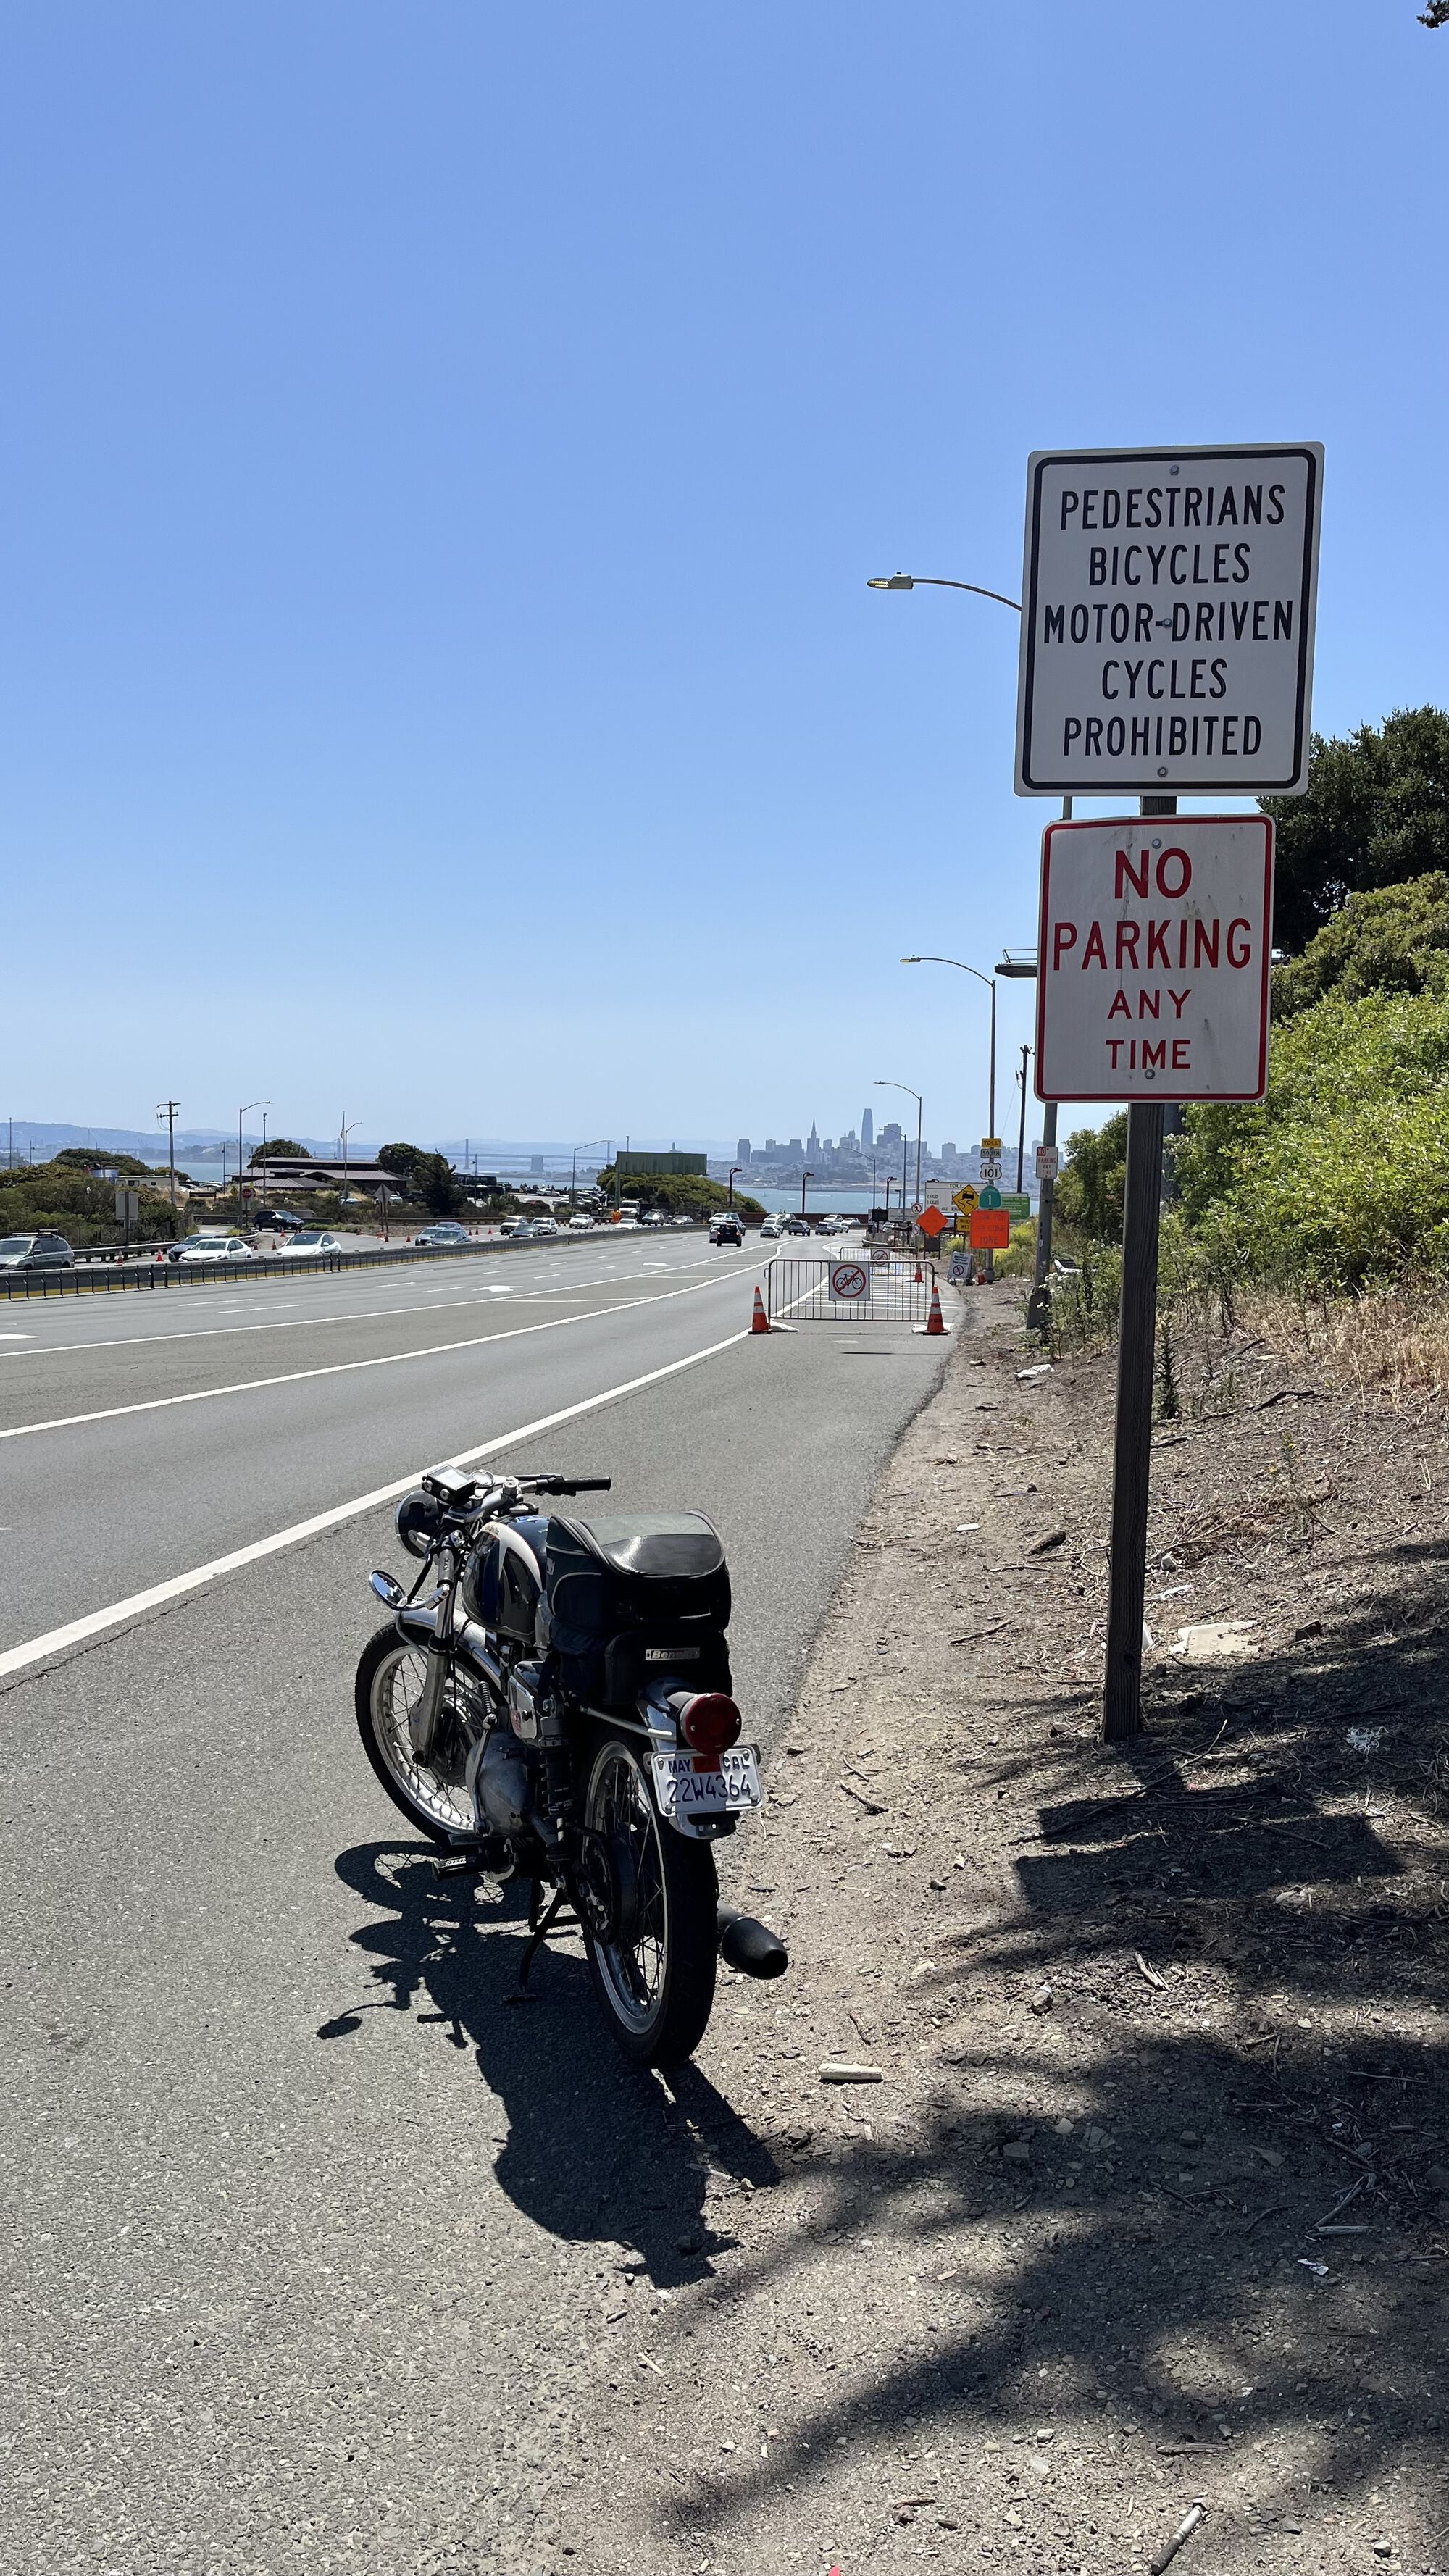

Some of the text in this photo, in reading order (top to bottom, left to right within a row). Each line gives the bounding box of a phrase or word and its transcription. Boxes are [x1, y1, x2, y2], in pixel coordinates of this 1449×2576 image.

[1060, 484, 1285, 530] PEDESTRIANS
[1089, 543, 1250, 586] BICYCLES
[1044, 601, 1293, 643] MOTOR-DRIVEN
[1102, 658, 1227, 700] CYCLES
[1063, 716, 1261, 756] PROHIBITED
[1114, 848, 1192, 899] NO
[1053, 918, 1251, 971] PARKING
[1107, 989, 1192, 1019] ANY
[1106, 1039, 1191, 1069] TIME
[984, 1168, 998, 1178] 101
[987, 1195, 992, 1205] 1
[668, 1759, 690, 1773] MAY
[723, 1756, 750, 1770] CAL
[667, 1774, 751, 1803] 22W4364
